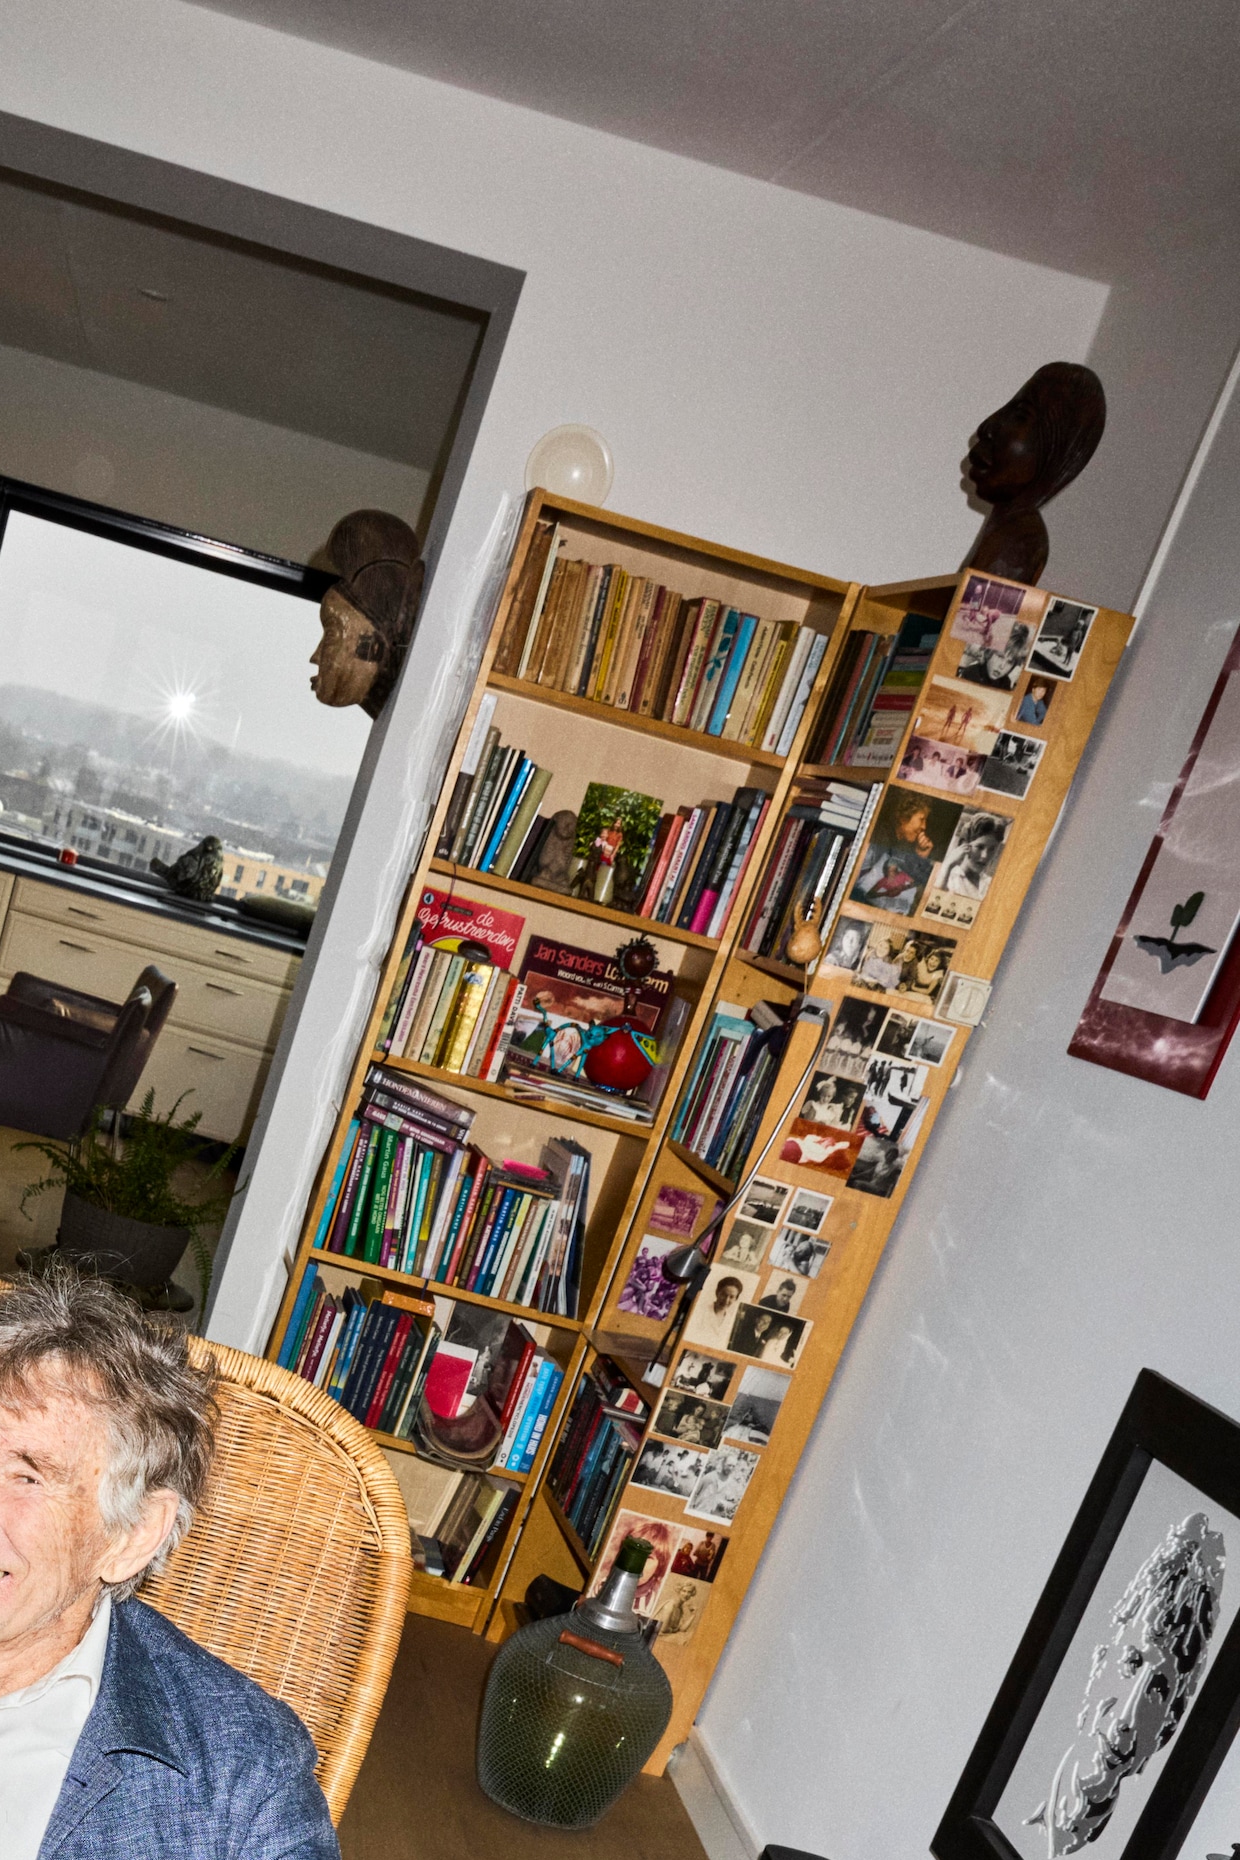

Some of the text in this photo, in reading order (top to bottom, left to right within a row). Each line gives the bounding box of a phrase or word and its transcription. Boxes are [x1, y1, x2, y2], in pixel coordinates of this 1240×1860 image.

[475, 908, 495, 928] de
[533, 942, 605, 976] Jan Sanders
[514, 986, 524, 1005] PATTI
[379, 1077, 449, 1111] HONDEMANIEREN
[377, 1134, 396, 1179] Martin Gaus
[533, 1413, 548, 1433] HOND
[530, 1431, 541, 1440] IN
[524, 1438, 538, 1456] HUIS
